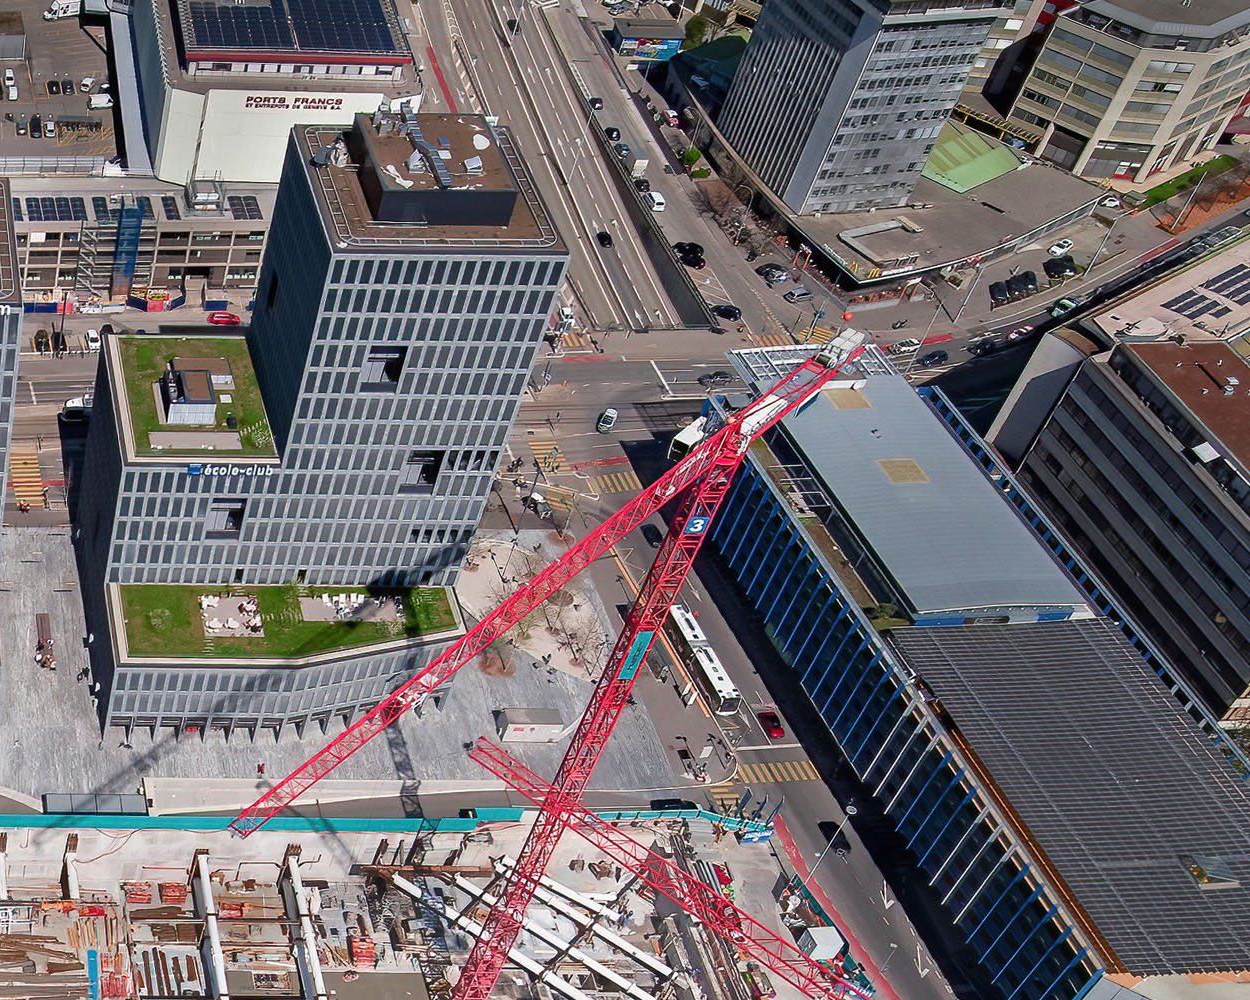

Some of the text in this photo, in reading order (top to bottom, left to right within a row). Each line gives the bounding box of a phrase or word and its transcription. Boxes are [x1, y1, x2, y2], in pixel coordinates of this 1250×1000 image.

[246, 96, 343, 105] PORTS FRANCS
[689, 519, 705, 532] 3
